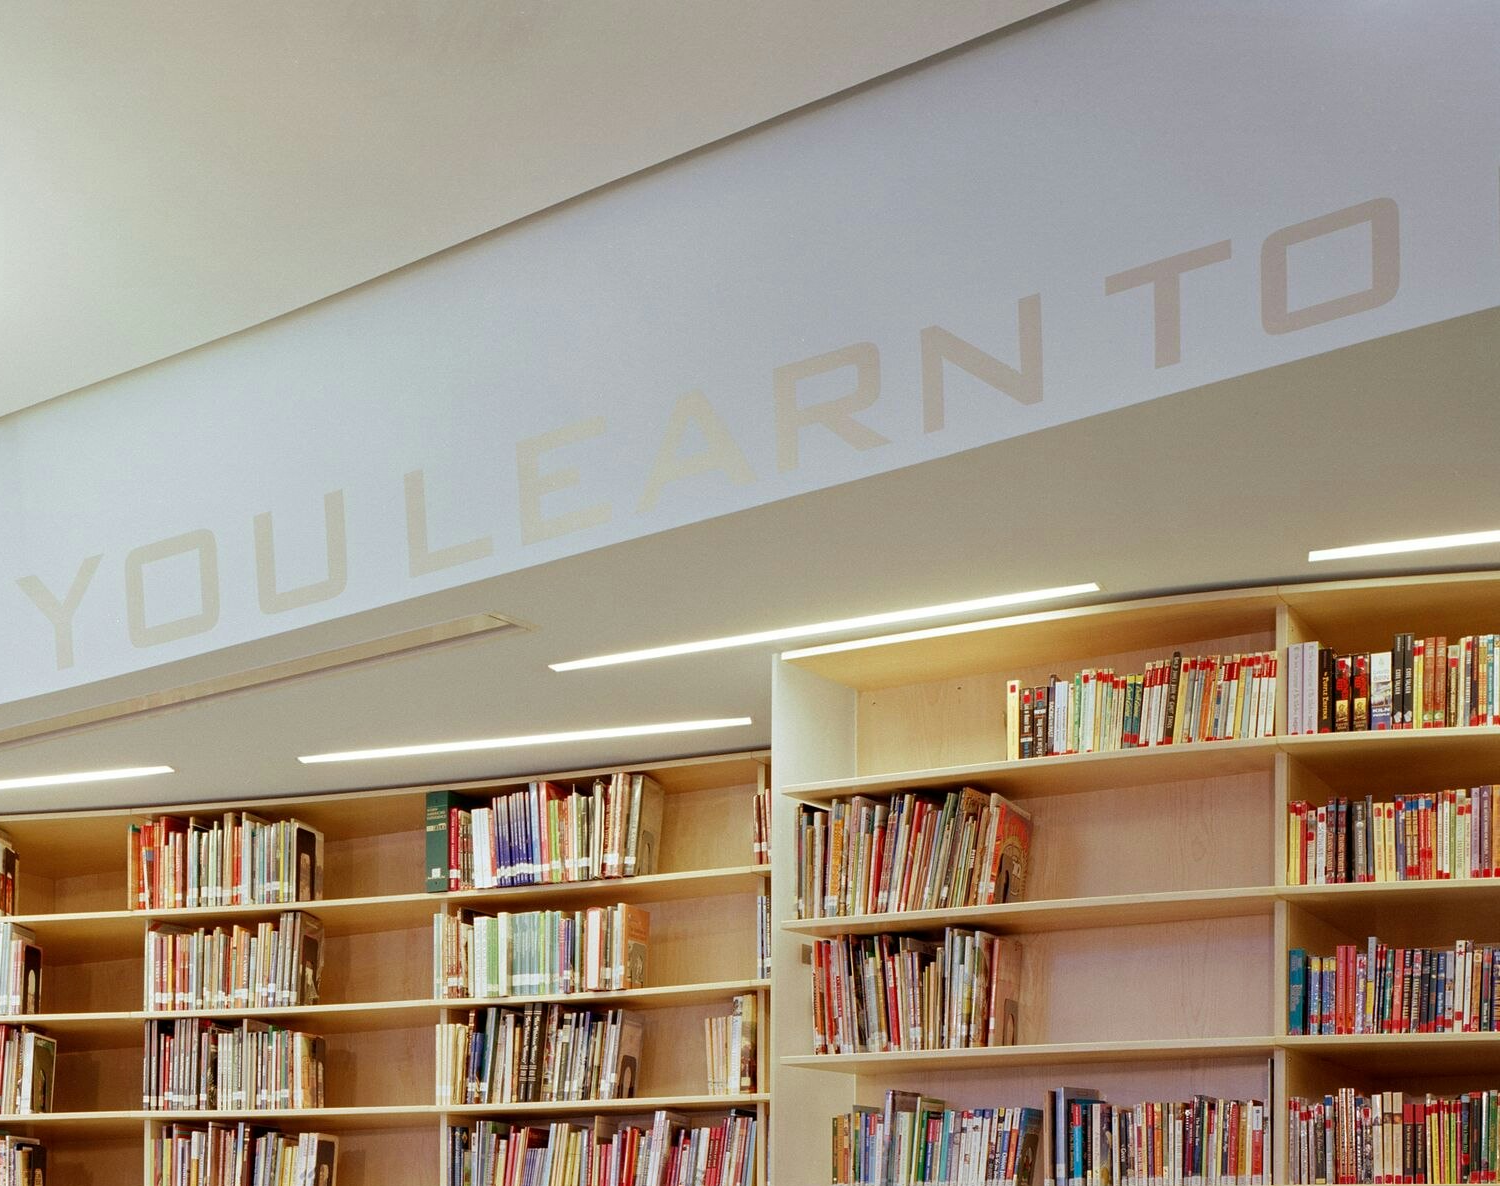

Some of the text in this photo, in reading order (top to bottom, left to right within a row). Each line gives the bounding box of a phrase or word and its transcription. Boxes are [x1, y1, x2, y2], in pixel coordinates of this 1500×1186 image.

[14, 488, 348, 672] YOU
[403, 292, 1044, 579] LEARN
[1104, 196, 1402, 371] TO
